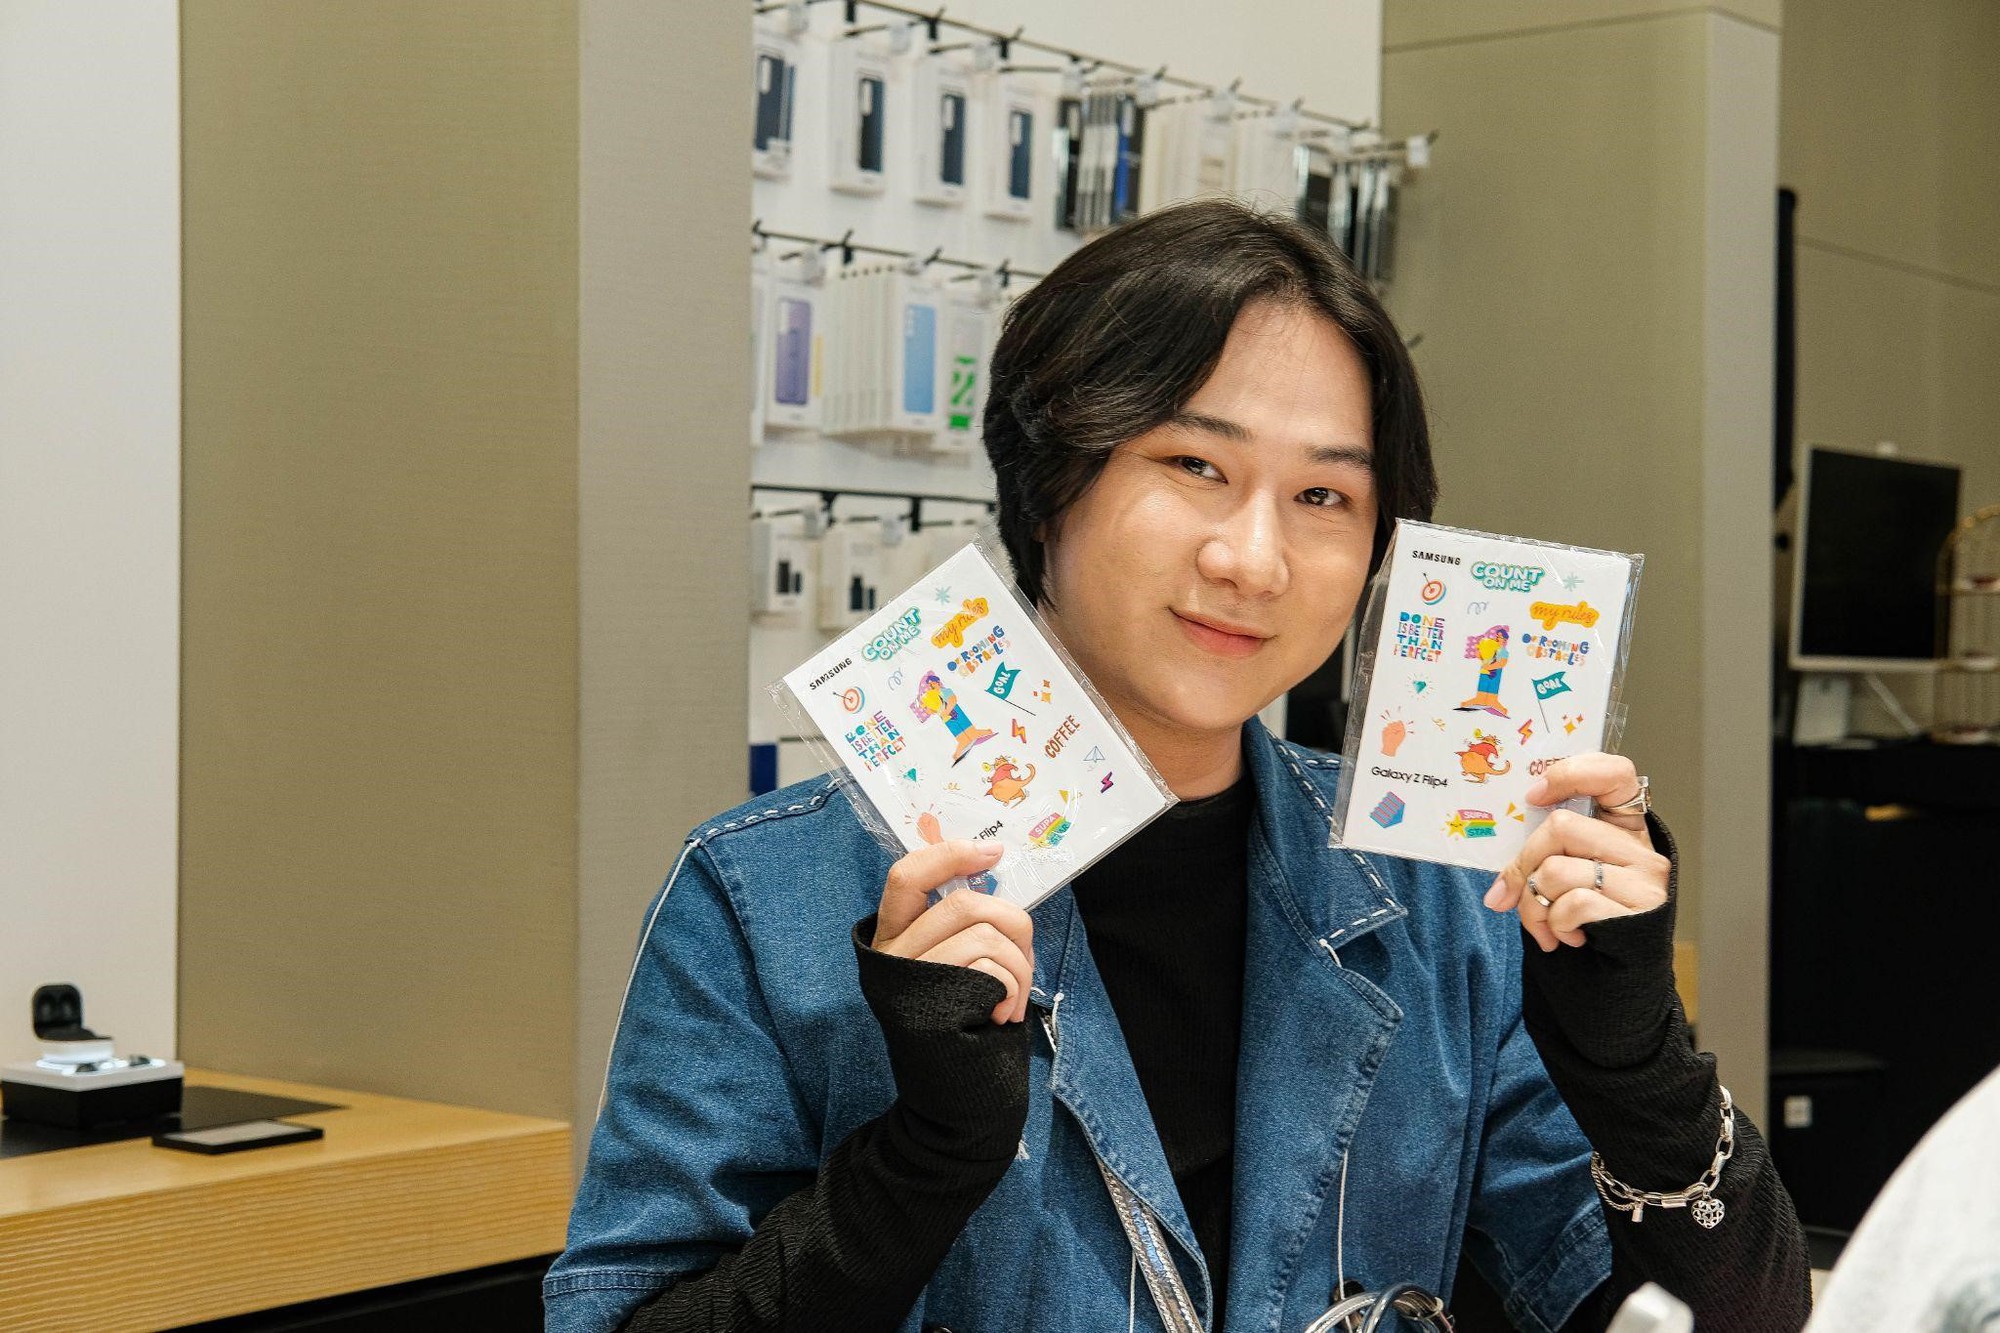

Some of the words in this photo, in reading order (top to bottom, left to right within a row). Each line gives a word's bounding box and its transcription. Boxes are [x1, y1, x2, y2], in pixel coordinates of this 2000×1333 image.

[1412, 550, 1461, 566] SAMSUNG
[1471, 561, 1545, 586] COUNT
[1482, 577, 1507, 590] ON
[1509, 579, 1531, 592] ME
[1400, 611, 1445, 628] DONE
[1533, 605, 1558, 627] my
[1559, 604, 1594, 624] rules
[862, 606, 921, 661] COUNT
[879, 640, 902, 661] ON
[898, 624, 921, 645] ME
[935, 622, 960, 645] my
[1397, 633, 1442, 651] THAN
[959, 638, 1010, 678] OBSTACLES
[1527, 645, 1585, 666] OBSTACLES
[809, 657, 853, 691] SAMSUNG
[993, 671, 1011, 694] GOAL
[1536, 677, 1562, 694] GOAL
[845, 710, 886, 744] DONE
[1045, 715, 1080, 759] COFFEE
[858, 728, 900, 759] THAN
[1371, 766, 1412, 784] Galaxy
[1413, 773, 1421, 783] Z
[1422, 774, 1448, 788] Flip4
[979, 819, 1003, 841] Flip4
[1467, 827, 1492, 837] STAR
